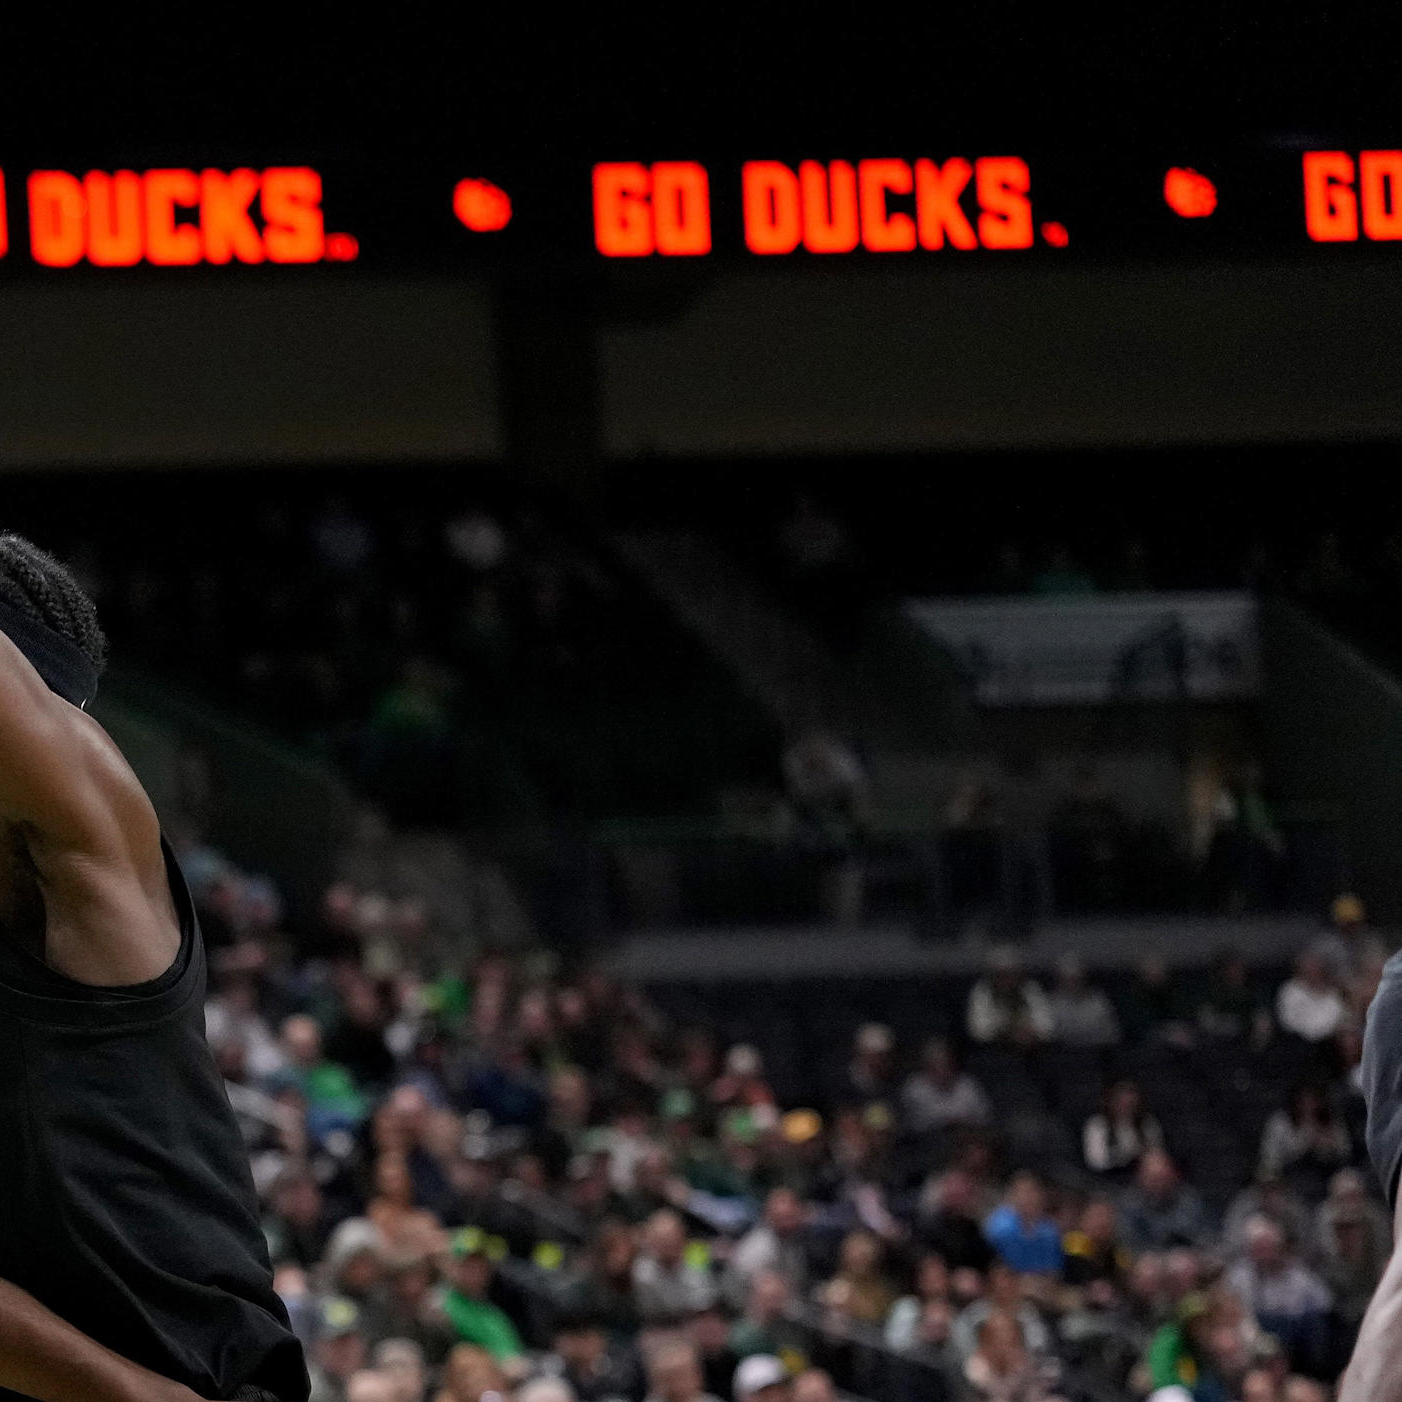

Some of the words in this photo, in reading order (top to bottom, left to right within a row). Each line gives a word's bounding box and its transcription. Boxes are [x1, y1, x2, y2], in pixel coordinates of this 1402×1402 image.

[27, 166, 359, 267] DUCKS.
[592, 161, 712, 258] GO
[742, 156, 1070, 255] DUCKS.
[1302, 149, 1402, 243] GO
